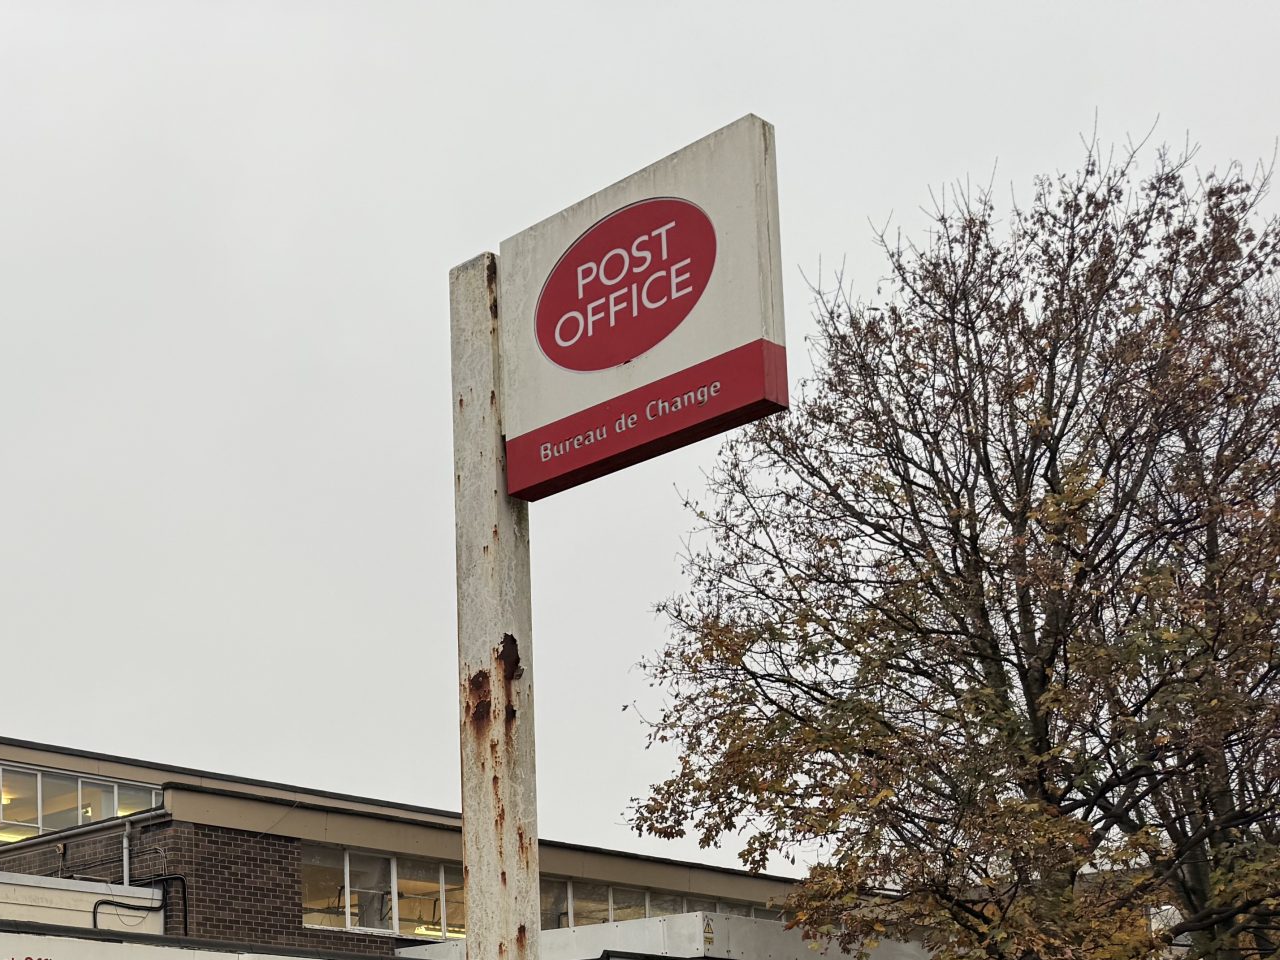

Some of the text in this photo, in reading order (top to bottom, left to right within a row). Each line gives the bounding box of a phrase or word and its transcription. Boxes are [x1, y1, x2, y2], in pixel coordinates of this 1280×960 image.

[577, 221, 676, 299] POST
[554, 257, 693, 347] OFFICE
[539, 381, 721, 462] Bureau de Change
